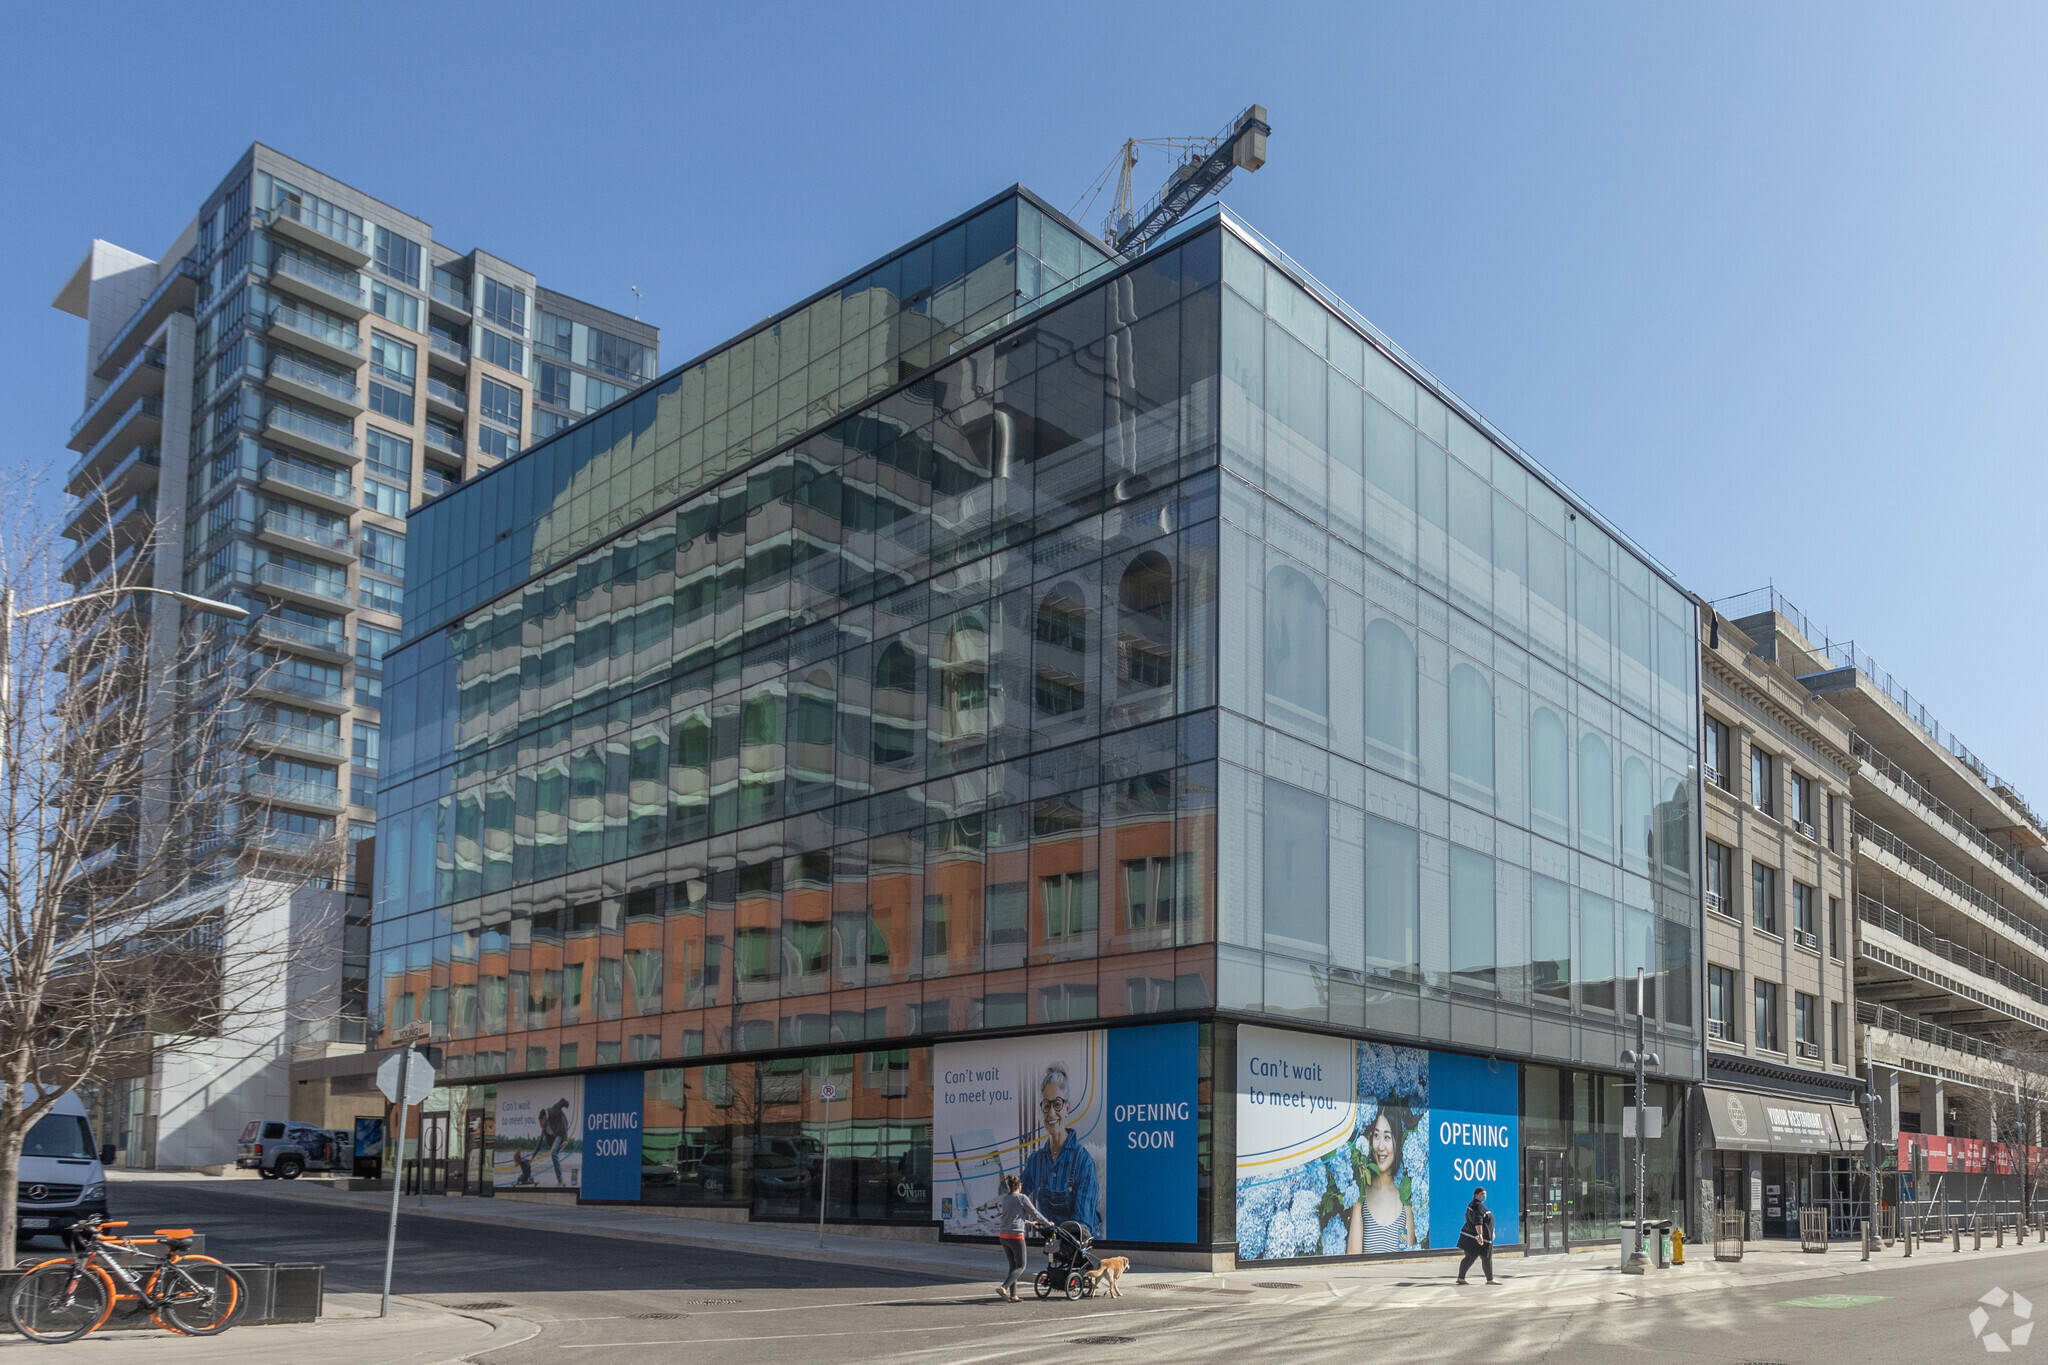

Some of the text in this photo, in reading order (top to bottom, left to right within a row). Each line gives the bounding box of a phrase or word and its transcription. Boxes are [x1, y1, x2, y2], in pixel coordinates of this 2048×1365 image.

[399, 1028, 419, 1038] YOUNG
[945, 1067, 1000, 1084] Can't wait
[1250, 1057, 1322, 1081] Can't wait
[502, 1101, 531, 1112] Can't wait
[945, 1089, 1012, 1106] to meet you.
[1250, 1086, 1337, 1114] to meet you.
[502, 1116, 536, 1126] to meet you.
[588, 1111, 638, 1131] OPENING
[1114, 1102, 1189, 1122] OPENING
[1787, 1109, 1824, 1129] RESTAURANT
[1128, 1131, 1174, 1149] SOON
[1440, 1121, 1508, 1148] OPENING
[595, 1139, 628, 1157] SOON
[1453, 1158, 1496, 1181] SOON
